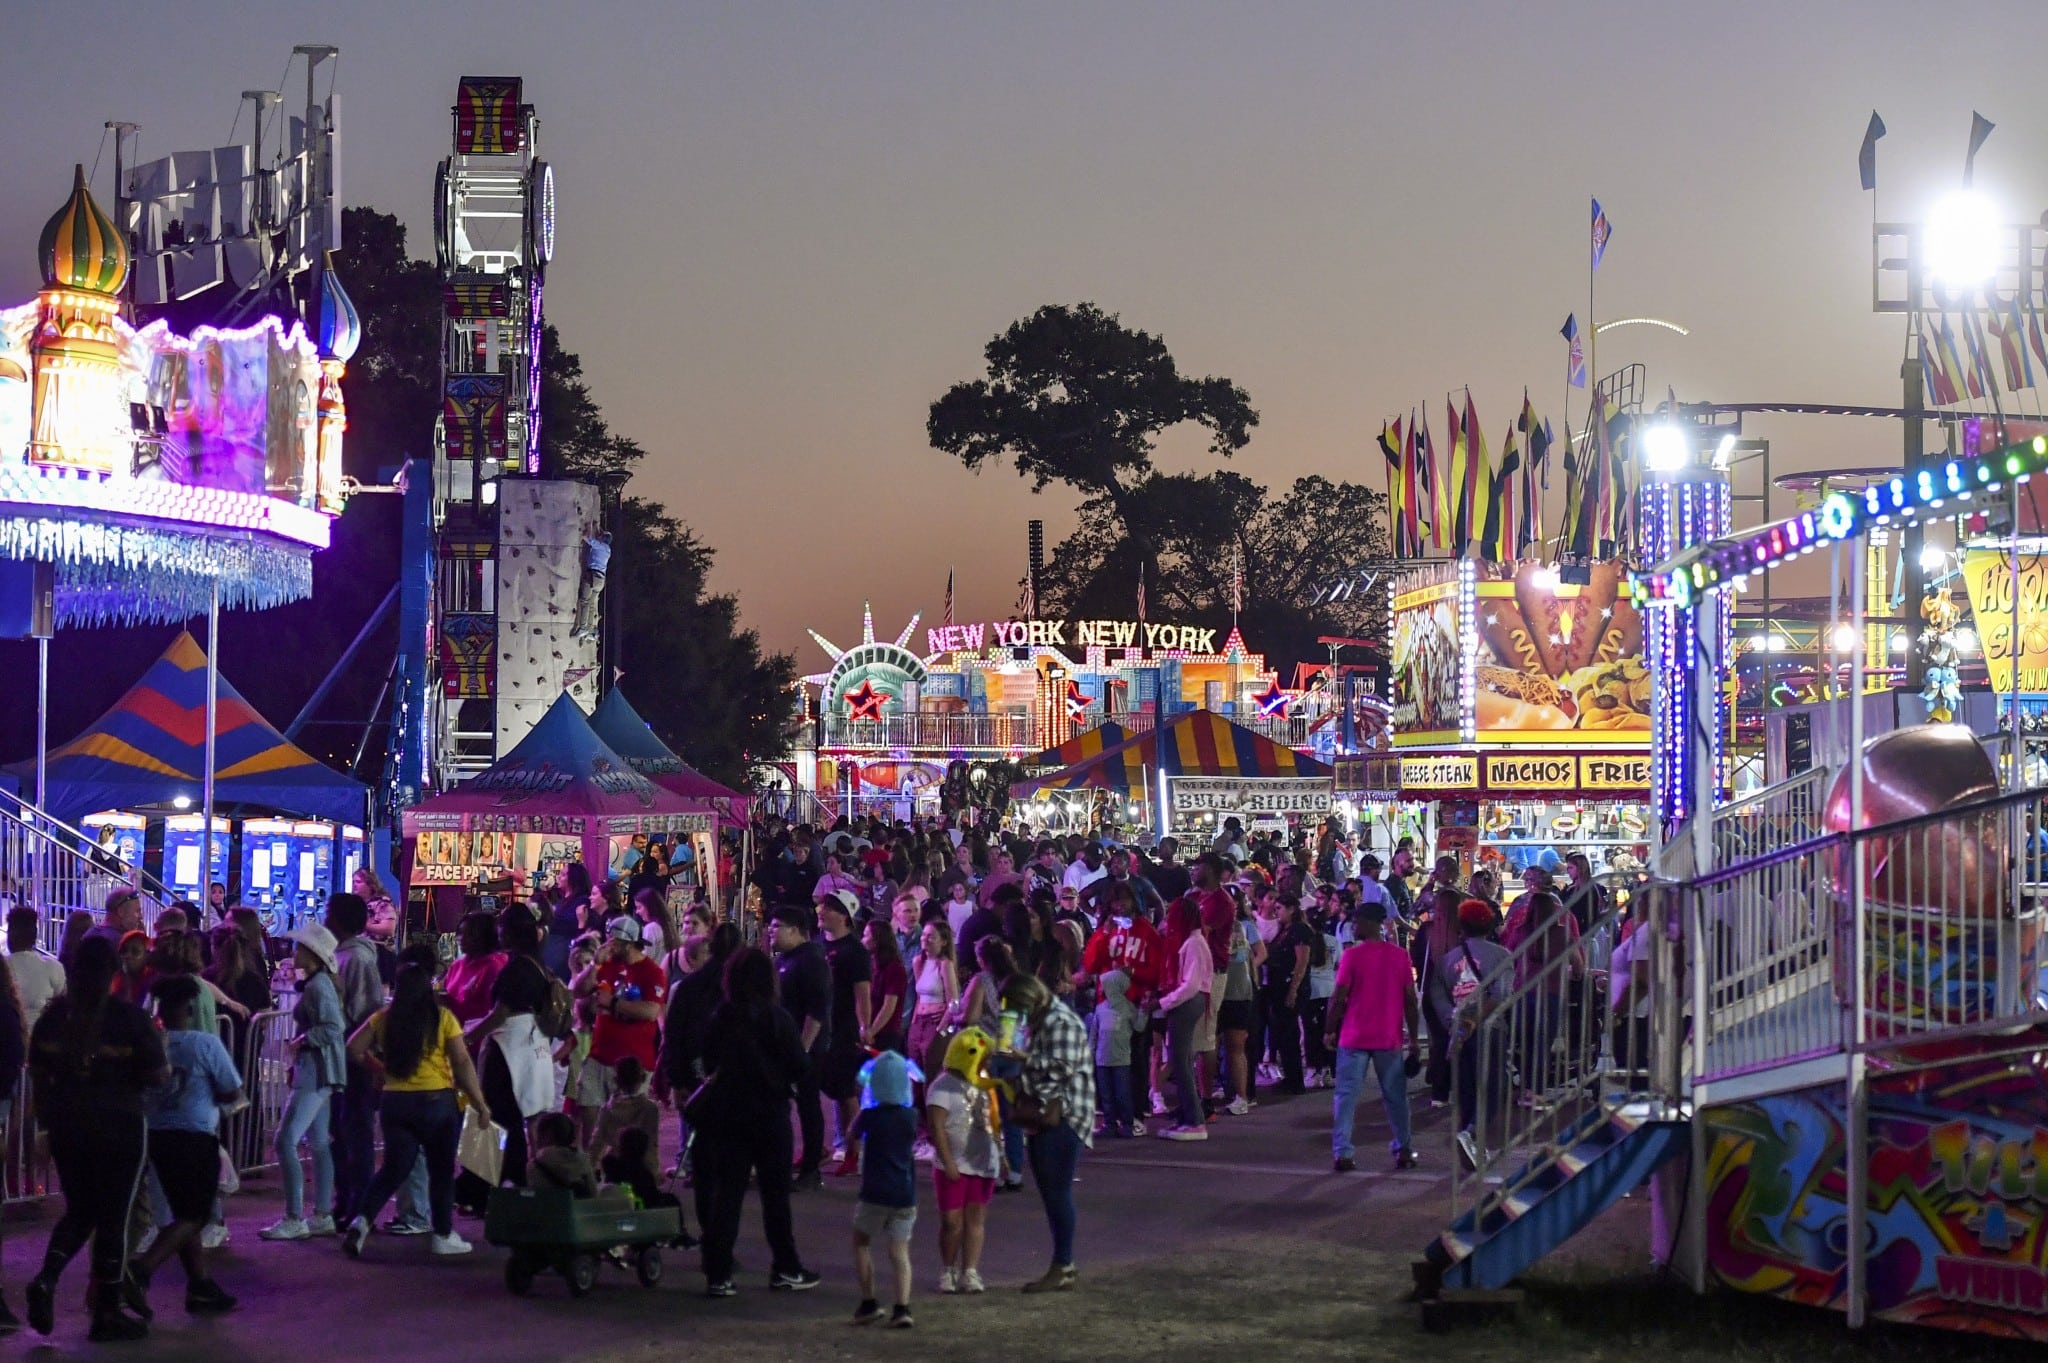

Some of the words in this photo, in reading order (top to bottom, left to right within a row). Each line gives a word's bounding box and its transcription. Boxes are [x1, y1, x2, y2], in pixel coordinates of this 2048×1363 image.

[1979, 558, 2048, 614] HOO
[927, 622, 985, 652] NEW
[993, 620, 1066, 648] YORK
[1078, 621, 1137, 648] NEW
[1143, 622, 1217, 654] YORK
[1403, 764, 1430, 784] CHEESE
[1433, 764, 1472, 783] STEAK
[1491, 761, 1572, 784] NACHOS
[1181, 781, 1321, 791] MECHANICAL
[1178, 793, 1231, 810] BULL
[1251, 793, 1328, 811] RIDING
[426, 864, 463, 881] FACE
[463, 864, 503, 881] PANT
[1935, 1255, 2048, 1314] WHIR
